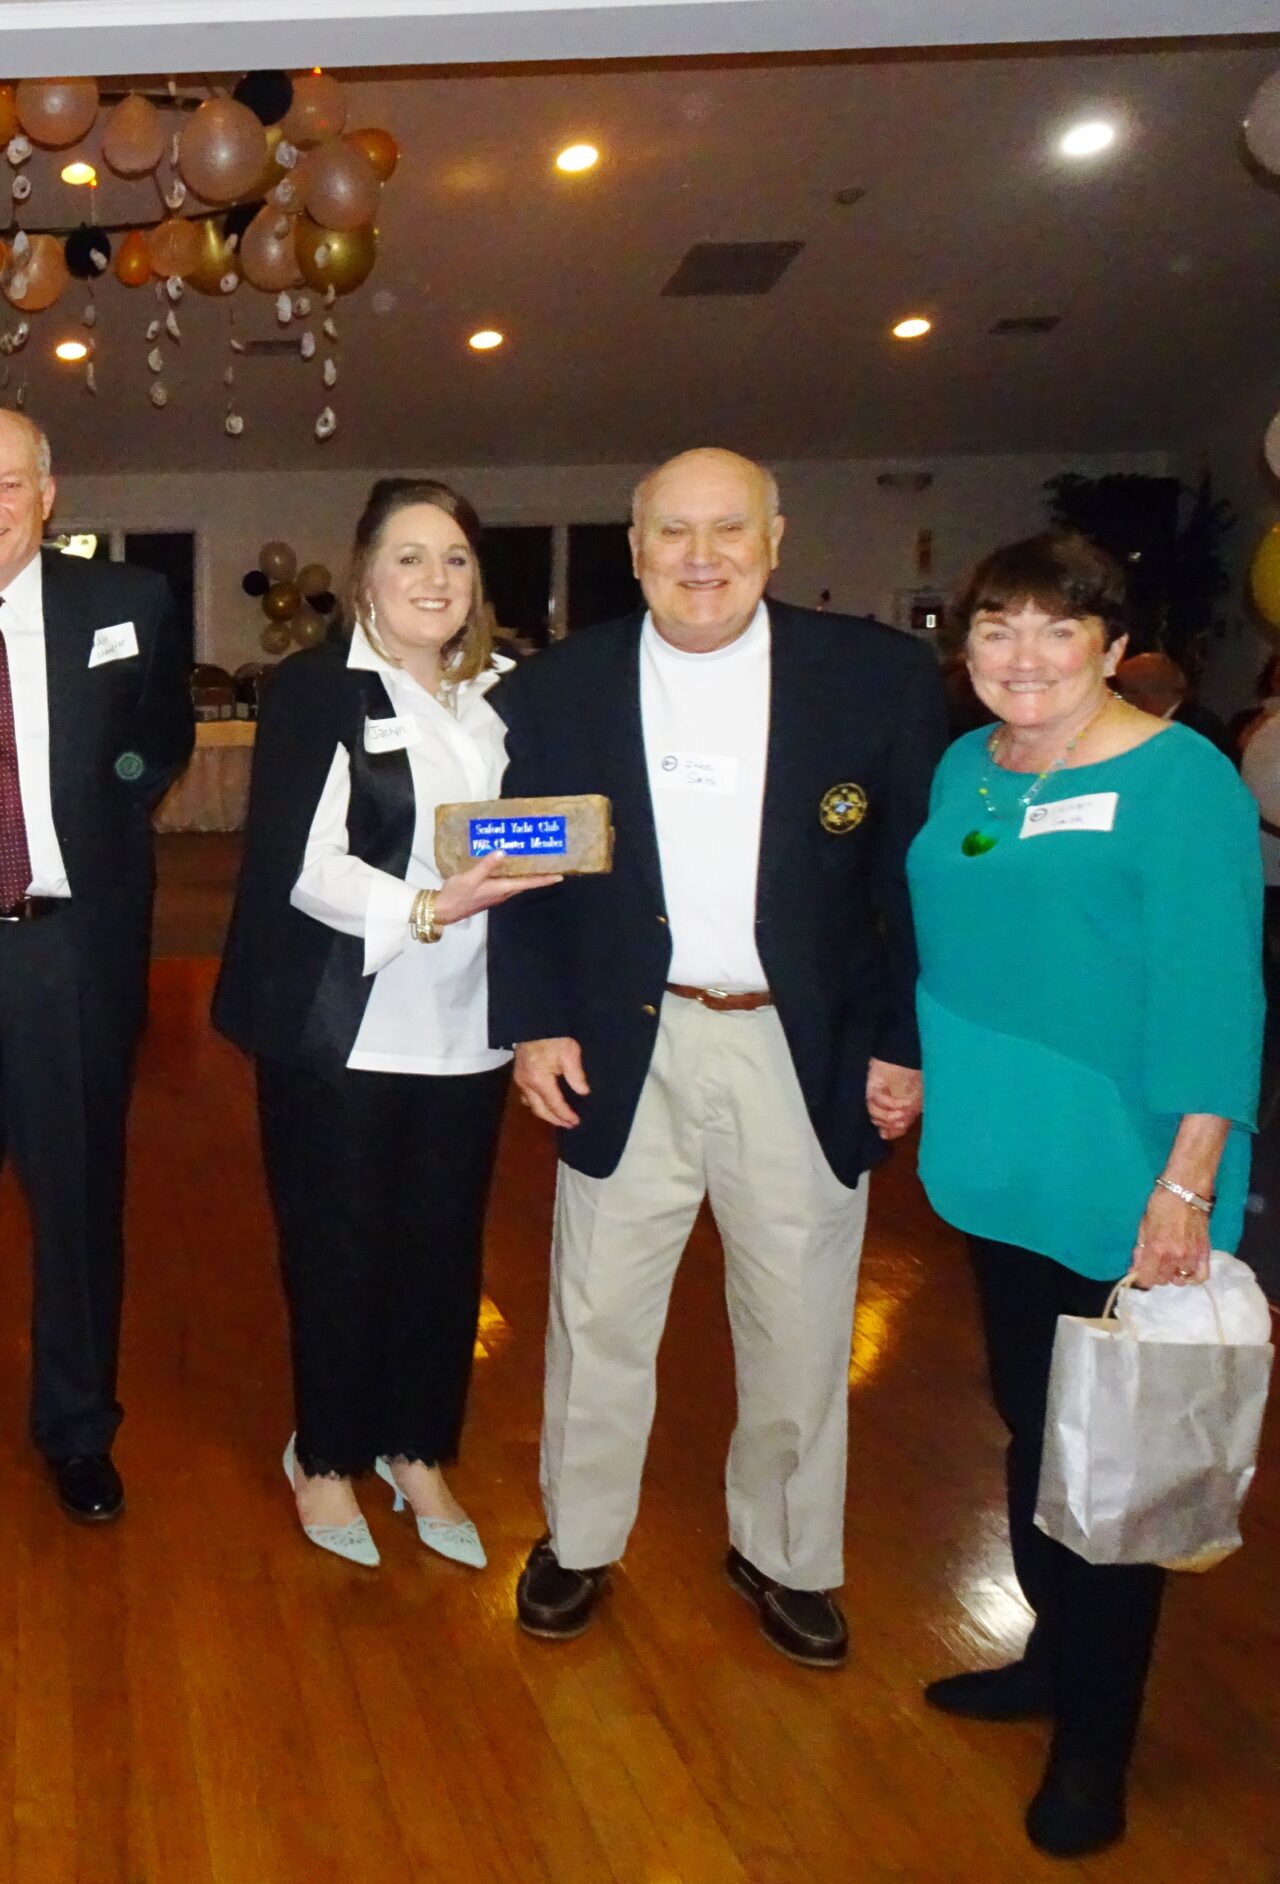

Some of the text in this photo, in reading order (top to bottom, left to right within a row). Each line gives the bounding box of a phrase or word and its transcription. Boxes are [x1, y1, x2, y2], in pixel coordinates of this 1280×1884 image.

[475, 820, 560, 835] Seaford Yacht Club
[493, 837, 525, 849] Charter
[529, 835, 563, 849] Member
